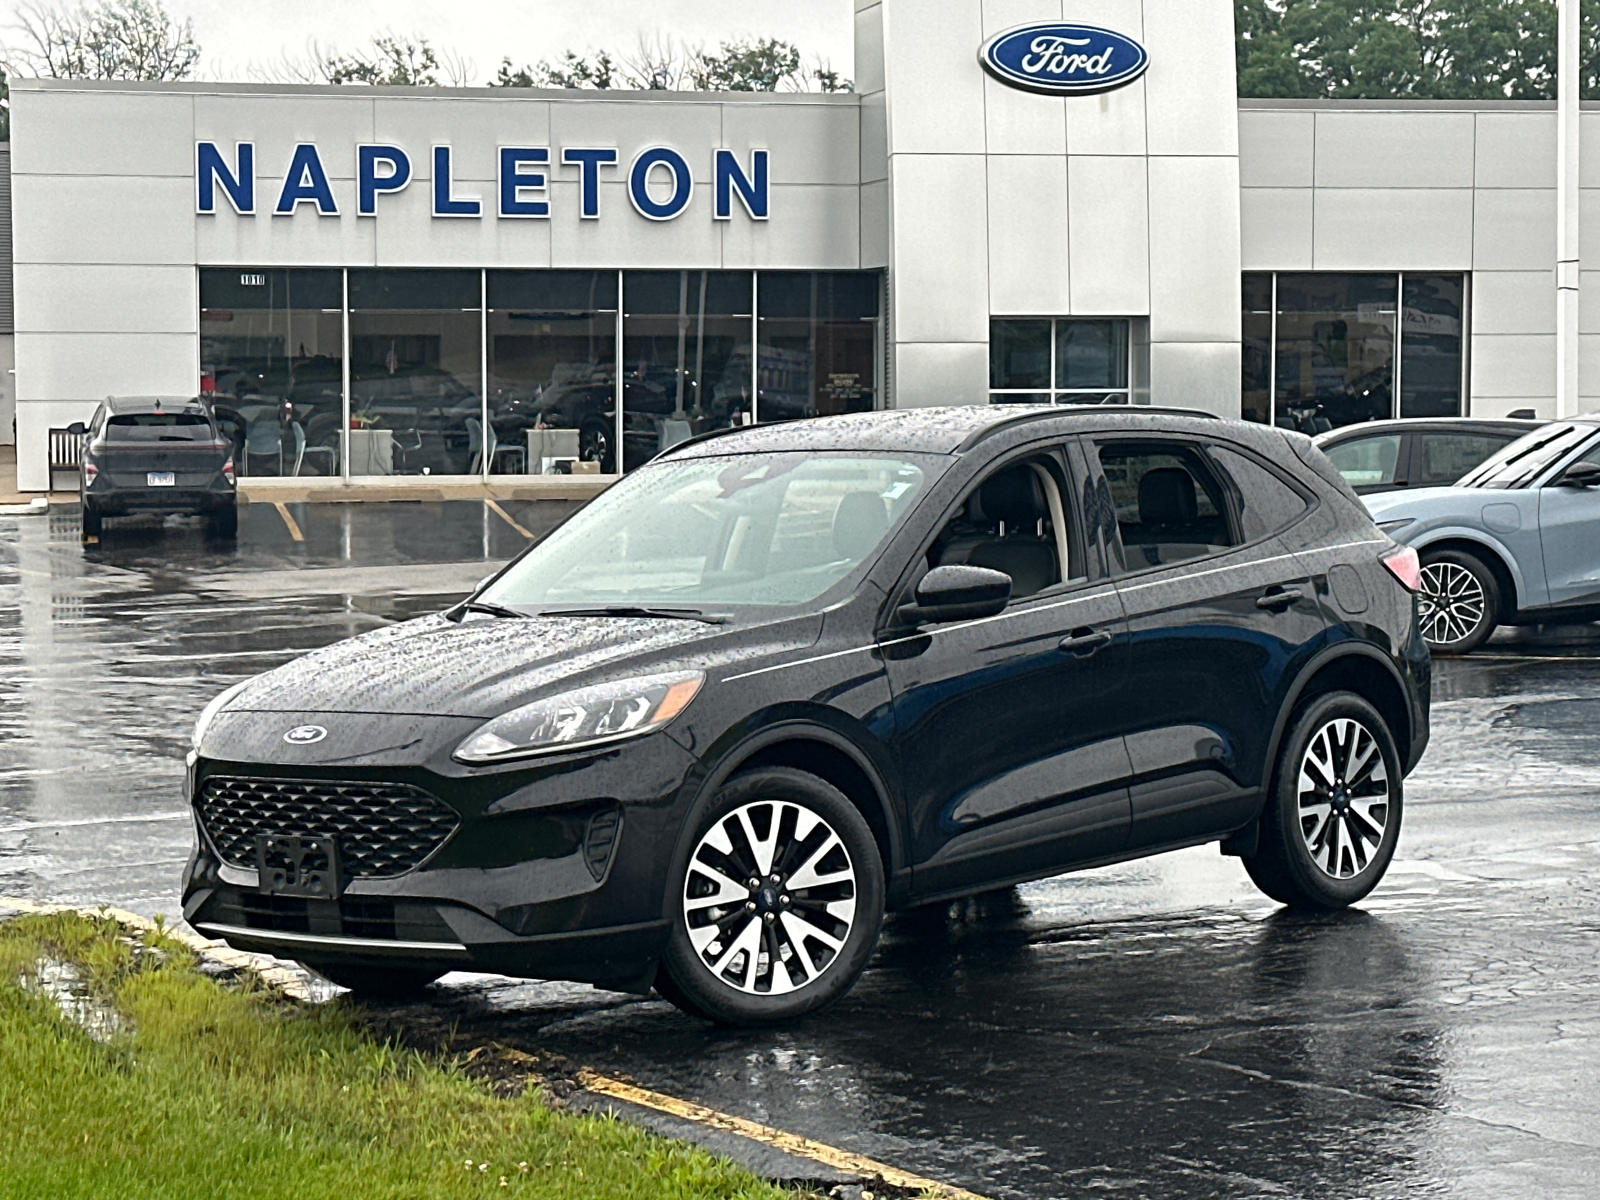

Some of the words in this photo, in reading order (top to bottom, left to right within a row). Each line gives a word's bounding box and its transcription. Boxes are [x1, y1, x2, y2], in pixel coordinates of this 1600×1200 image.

[1021, 35, 1114, 74] Ford
[196, 141, 770, 221] NAPLETON
[241, 274, 265, 285] 1010
